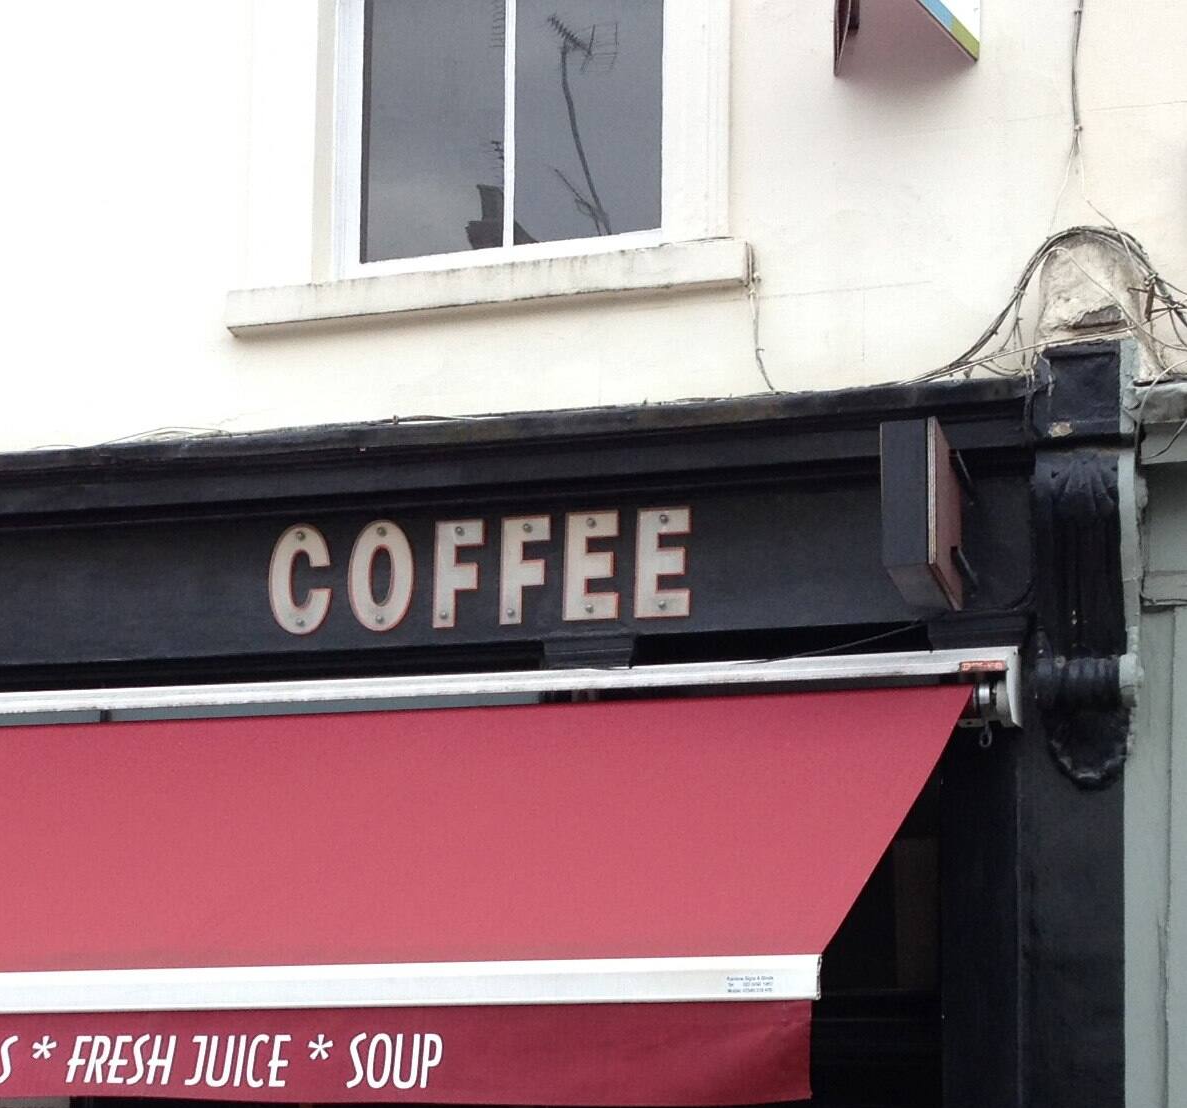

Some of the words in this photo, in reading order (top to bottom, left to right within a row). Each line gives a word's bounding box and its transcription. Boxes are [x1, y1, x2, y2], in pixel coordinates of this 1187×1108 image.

[268, 505, 692, 635] COFFEE
[65, 1034, 177, 1087] FRESH
[184, 1033, 292, 1089] JUICE
[345, 1032, 444, 1089] SOUP
